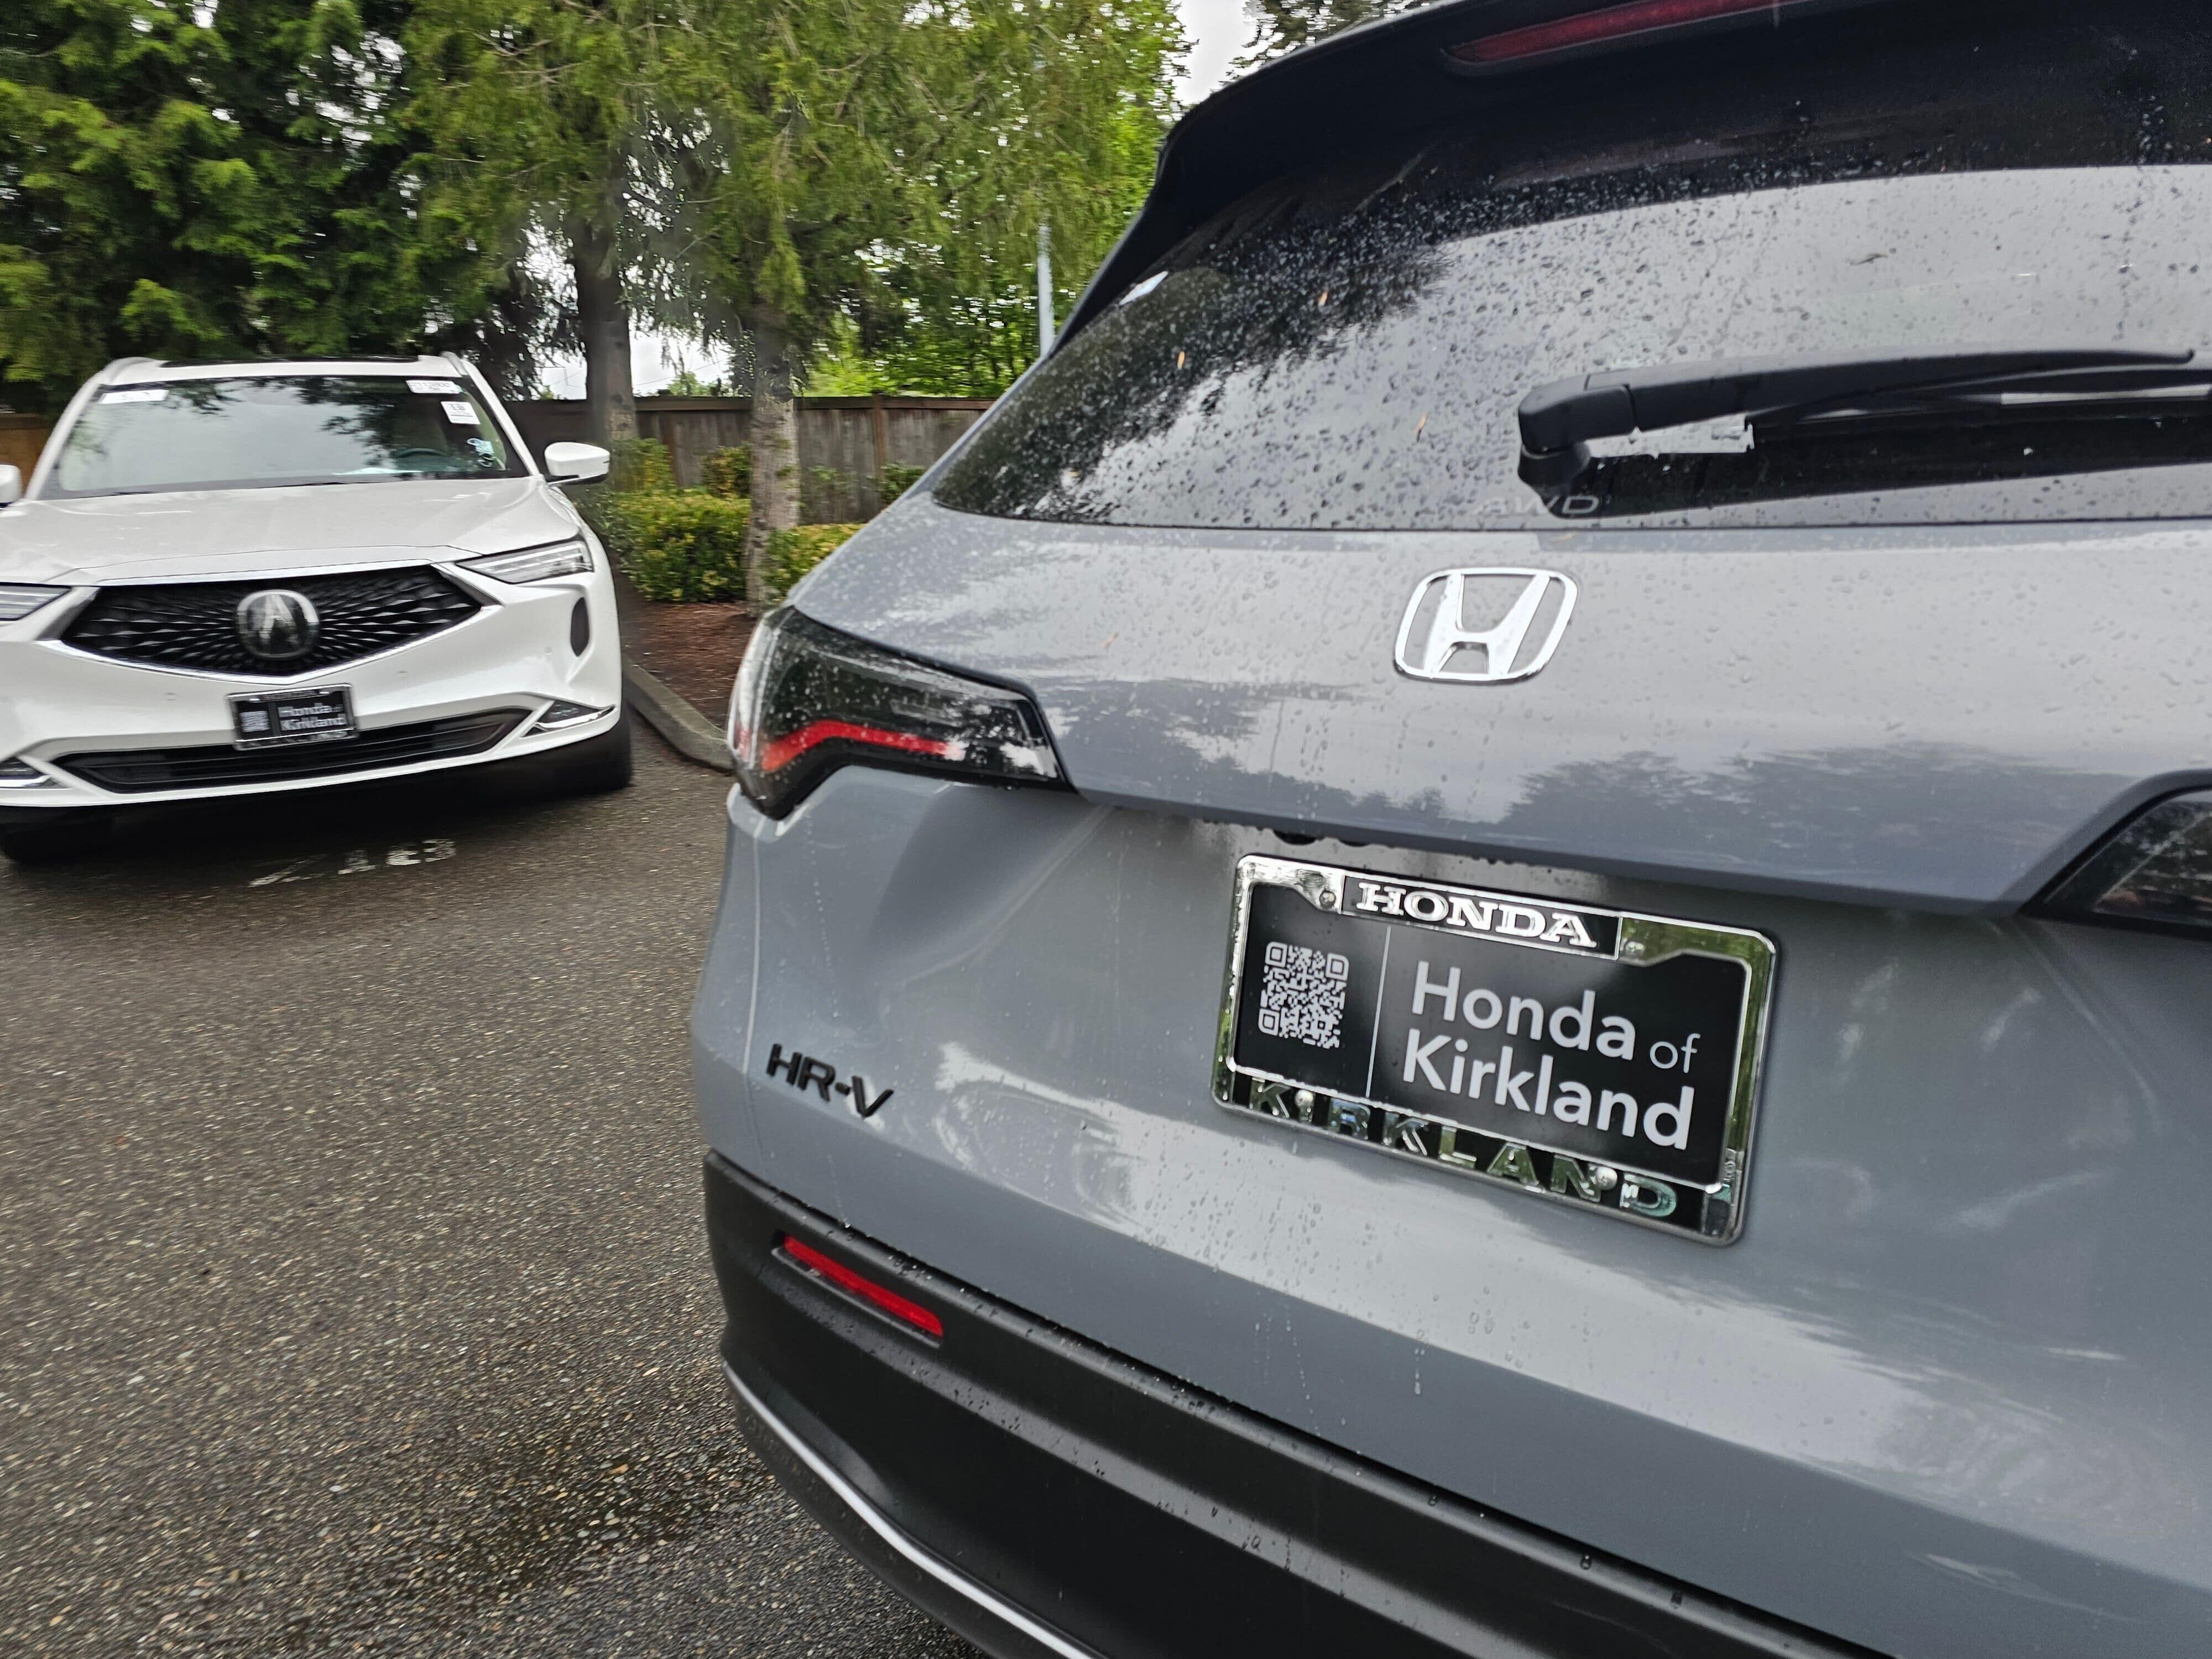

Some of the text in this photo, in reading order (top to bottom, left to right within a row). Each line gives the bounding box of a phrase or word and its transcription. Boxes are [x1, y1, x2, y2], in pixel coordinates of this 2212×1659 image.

[1356, 882, 1597, 948] HONDA
[1411, 961, 1701, 1073] Honda of
[765, 1043, 894, 1119] HR-V
[1403, 1029, 1694, 1150] Kirkland
